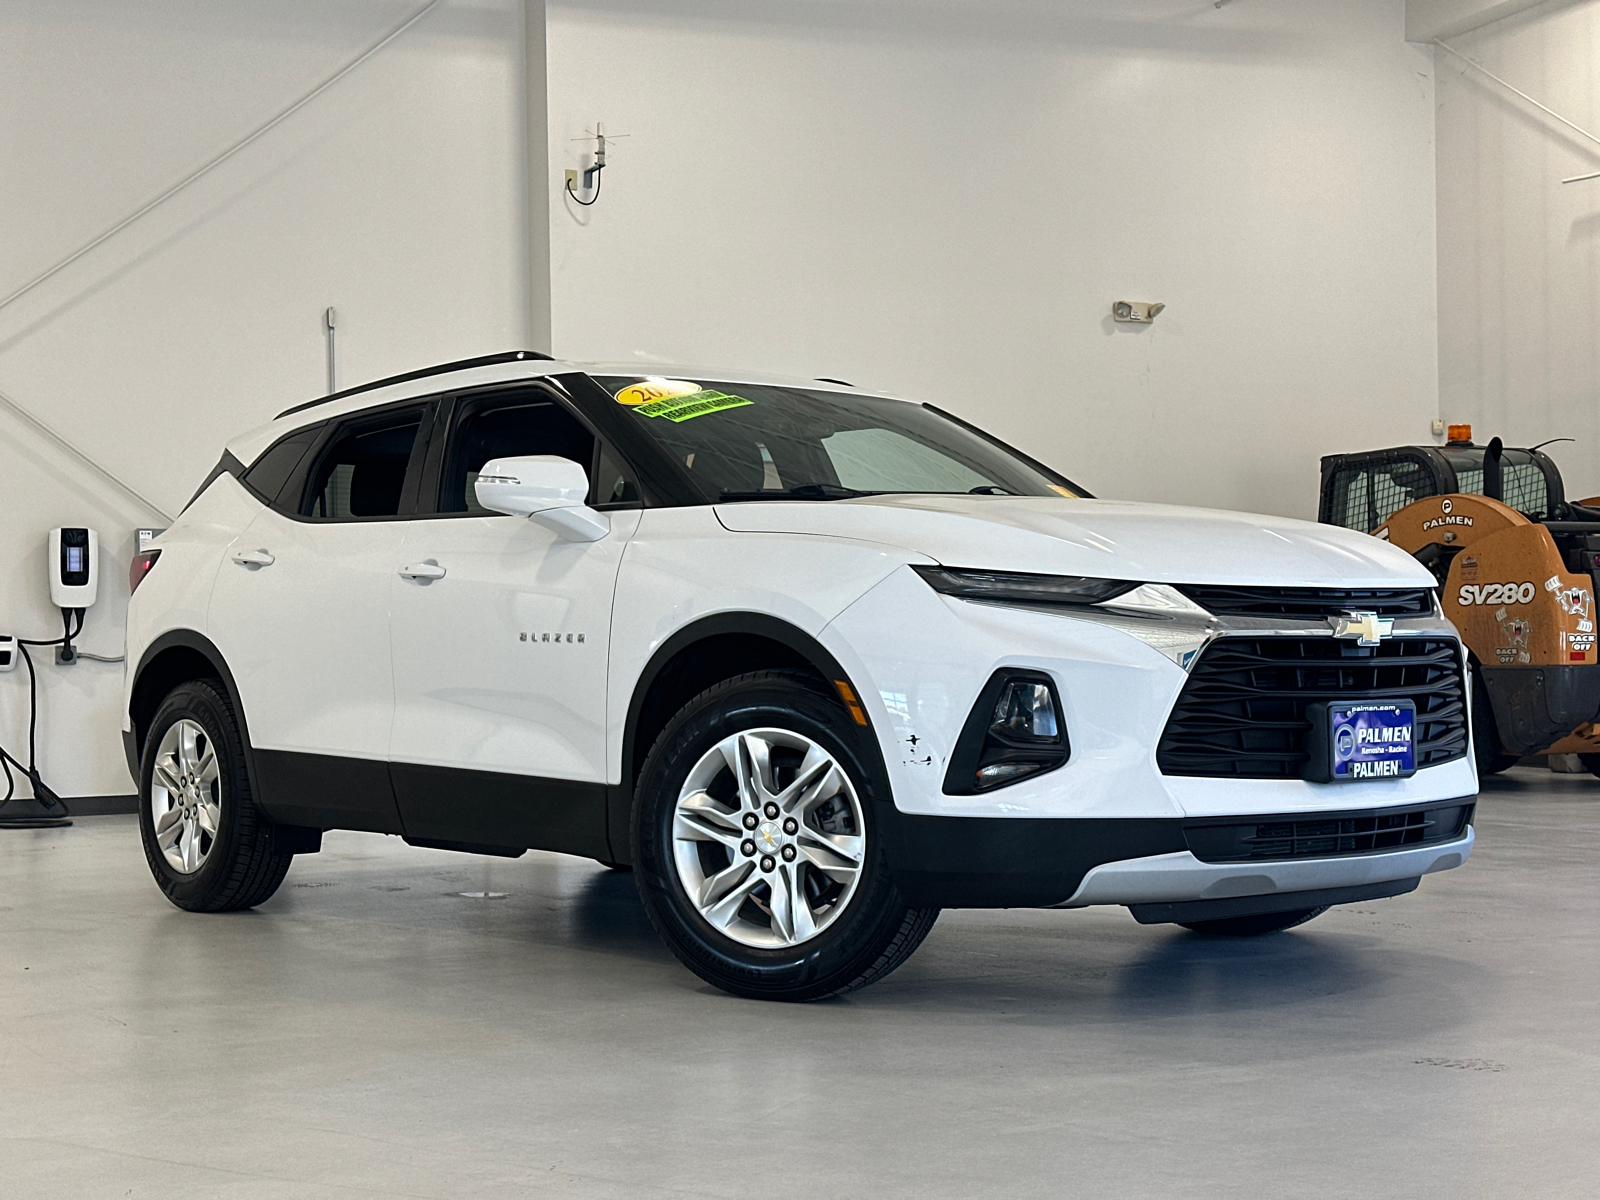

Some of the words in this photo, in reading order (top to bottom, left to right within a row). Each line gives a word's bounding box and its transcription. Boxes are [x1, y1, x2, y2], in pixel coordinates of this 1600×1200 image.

[1422, 515, 1473, 532] PALMEN
[1458, 582, 1536, 606] SV280
[519, 632, 586, 643] BLAZER
[1568, 634, 1596, 643] BACK
[1573, 643, 1592, 651] OFF
[1351, 705, 1396, 713] palmen.com
[1358, 727, 1412, 744] PALMEN
[1361, 746, 1385, 755] Kenosha
[1388, 745, 1408, 754] Racine
[1353, 760, 1399, 778] PALMEN
